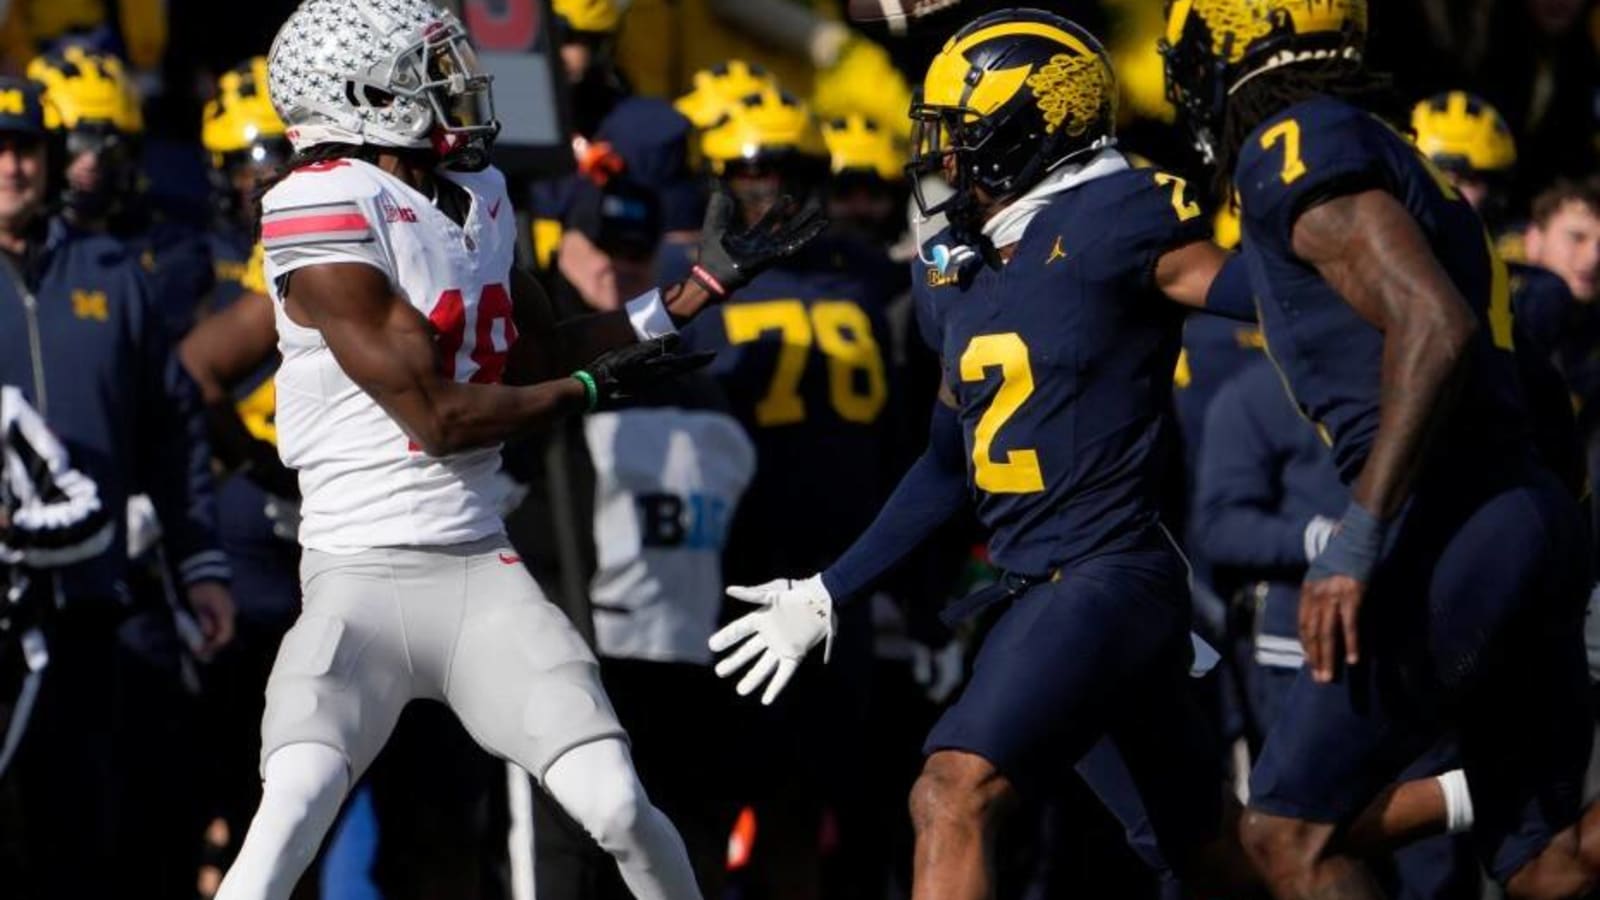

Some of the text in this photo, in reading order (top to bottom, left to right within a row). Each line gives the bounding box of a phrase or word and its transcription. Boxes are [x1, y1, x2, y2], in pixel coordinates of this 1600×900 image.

[1154, 171, 1201, 221] 2
[1260, 119, 1306, 185] 7
[427, 282, 519, 390] 18
[723, 299, 887, 426] 78
[959, 332, 1045, 493] 2
